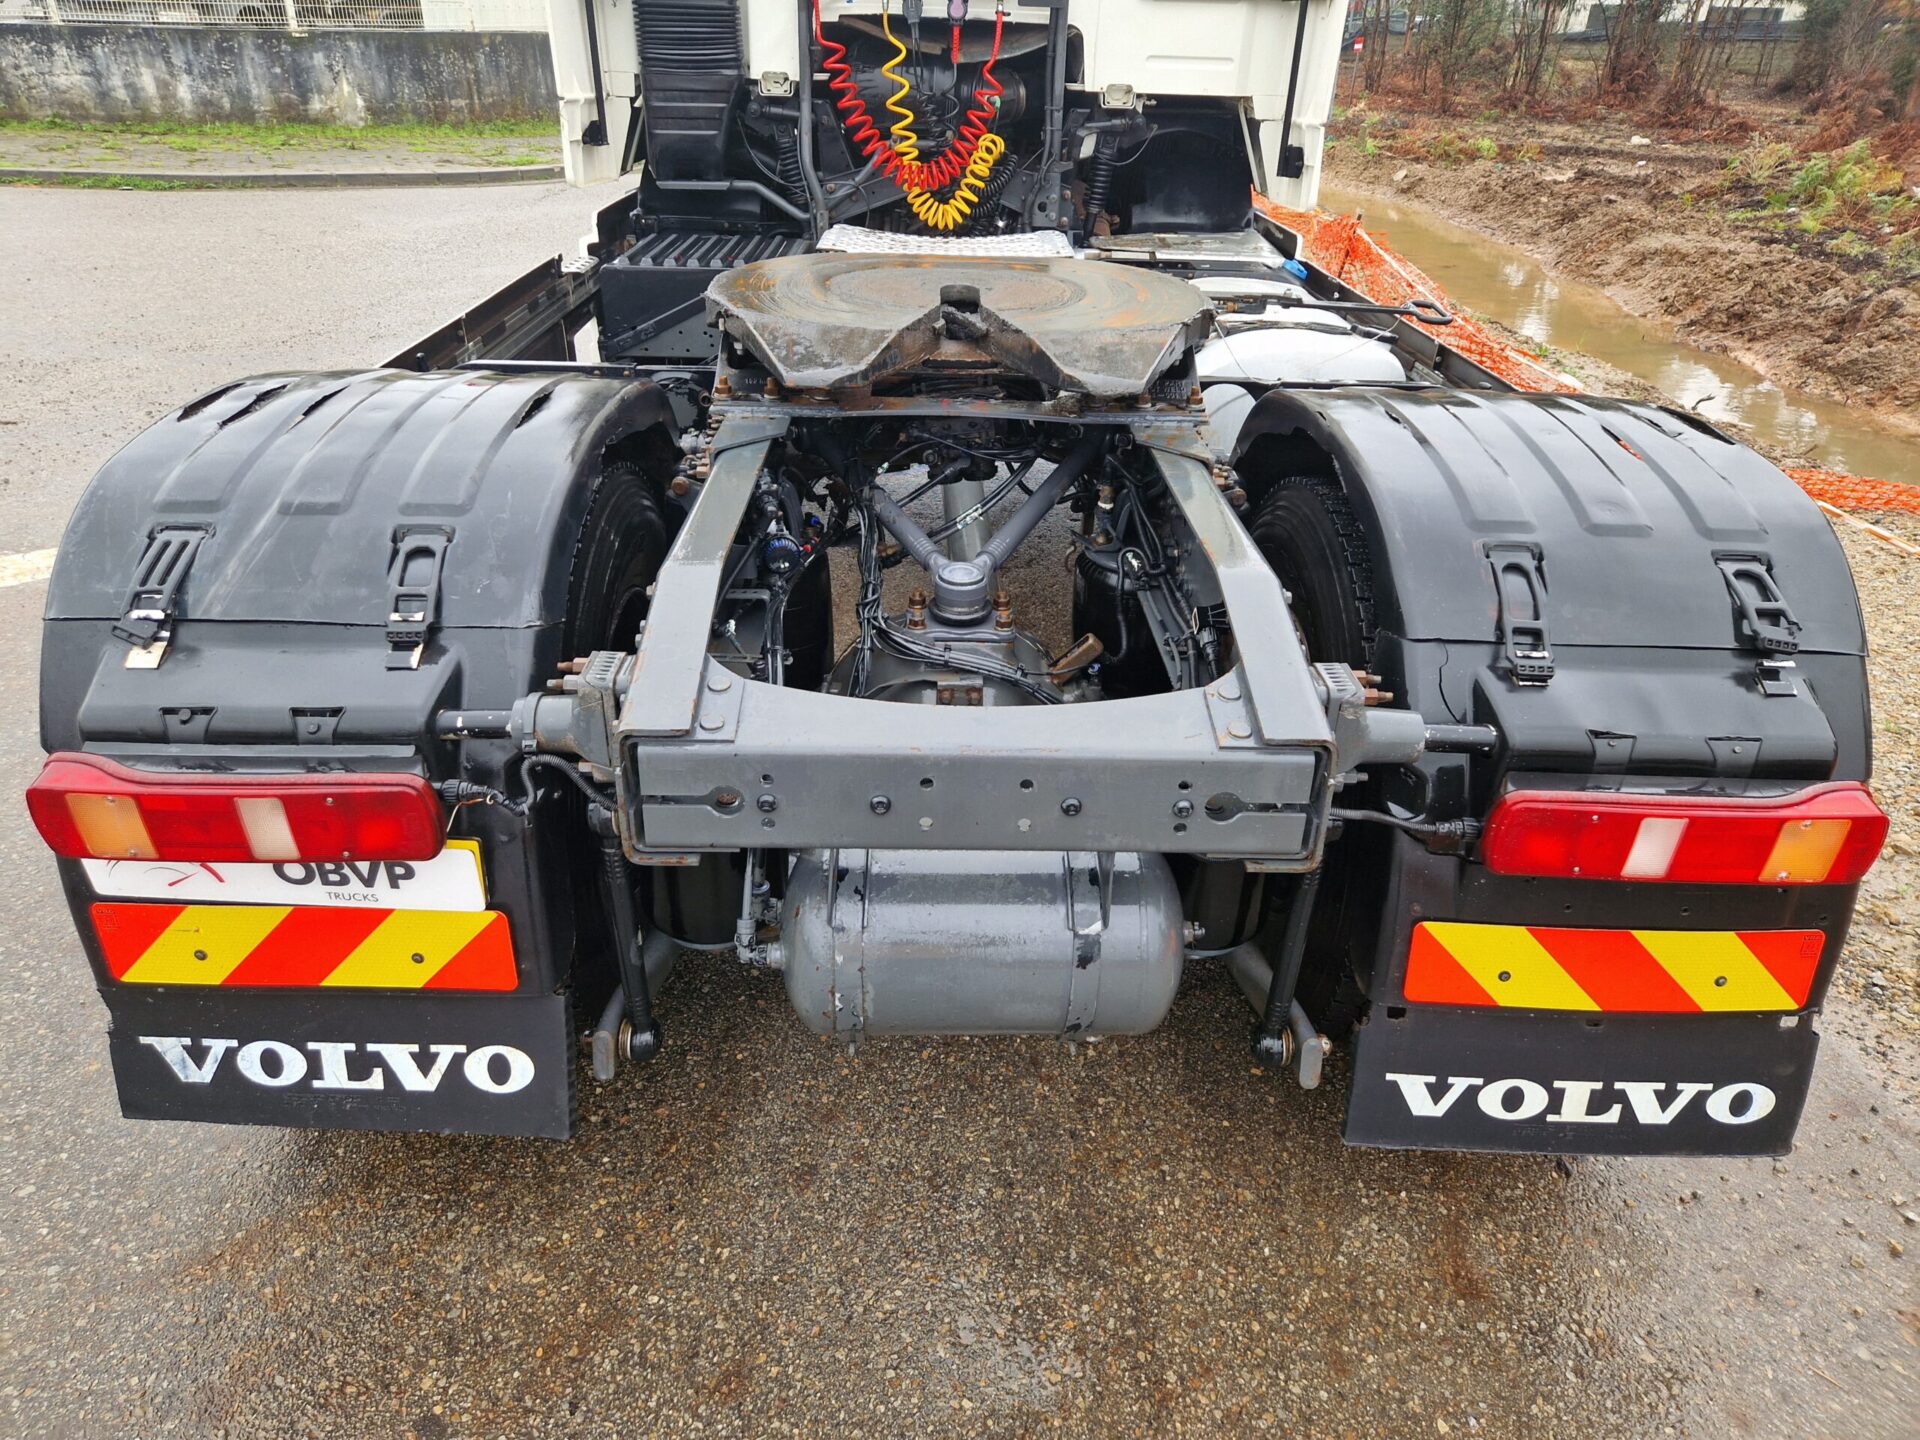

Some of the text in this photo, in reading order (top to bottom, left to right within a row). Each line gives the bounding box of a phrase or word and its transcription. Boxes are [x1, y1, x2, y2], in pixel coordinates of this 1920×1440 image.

[273, 861, 416, 890] OBVP
[325, 891, 379, 903] TRUCKS
[138, 1036, 536, 1094] VOLVO
[1385, 1073, 1777, 1125] VOLVO
